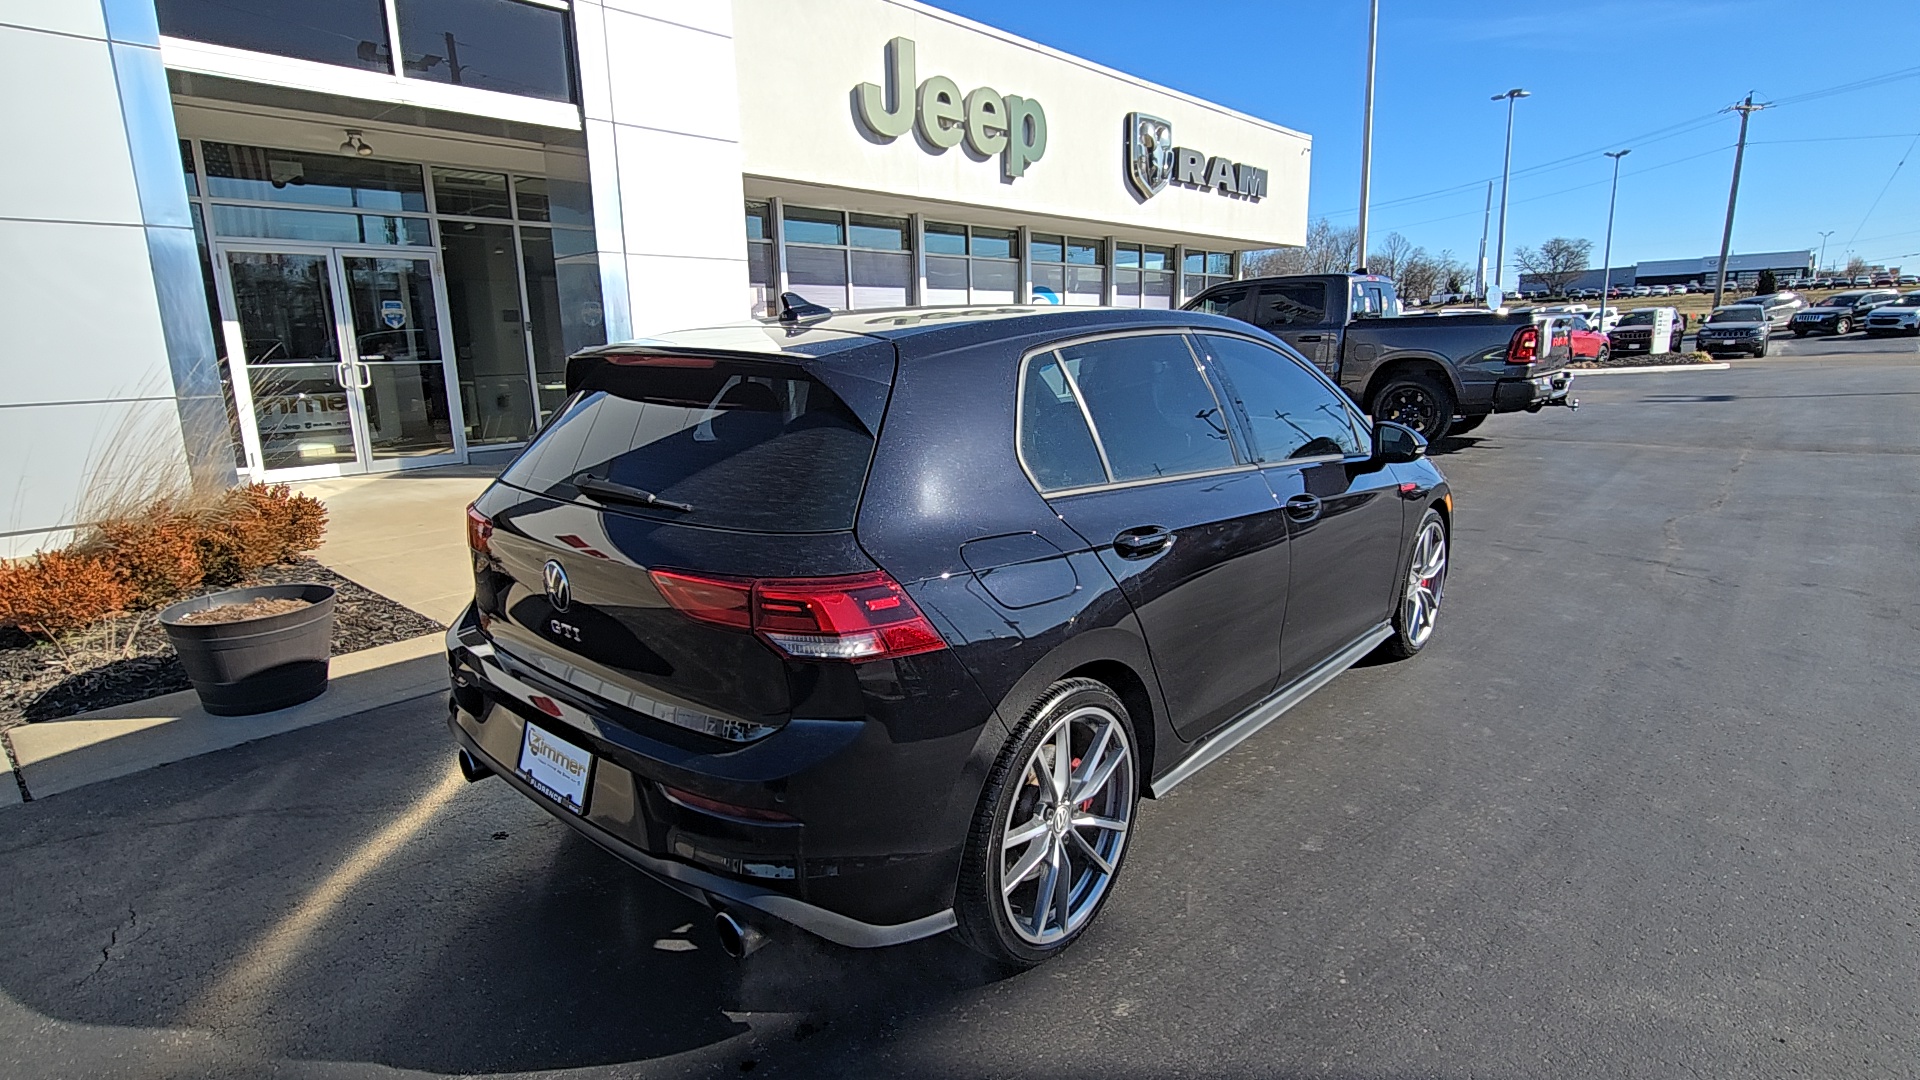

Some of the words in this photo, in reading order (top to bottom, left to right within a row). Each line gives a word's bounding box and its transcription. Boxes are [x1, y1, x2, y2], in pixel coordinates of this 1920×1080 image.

[854, 36, 1047, 178] Jeep
[1174, 146, 1269, 200] RAM
[551, 619, 581, 642] GTI
[528, 728, 587, 777] Zimmer
[530, 778, 563, 804] FLORENCE
